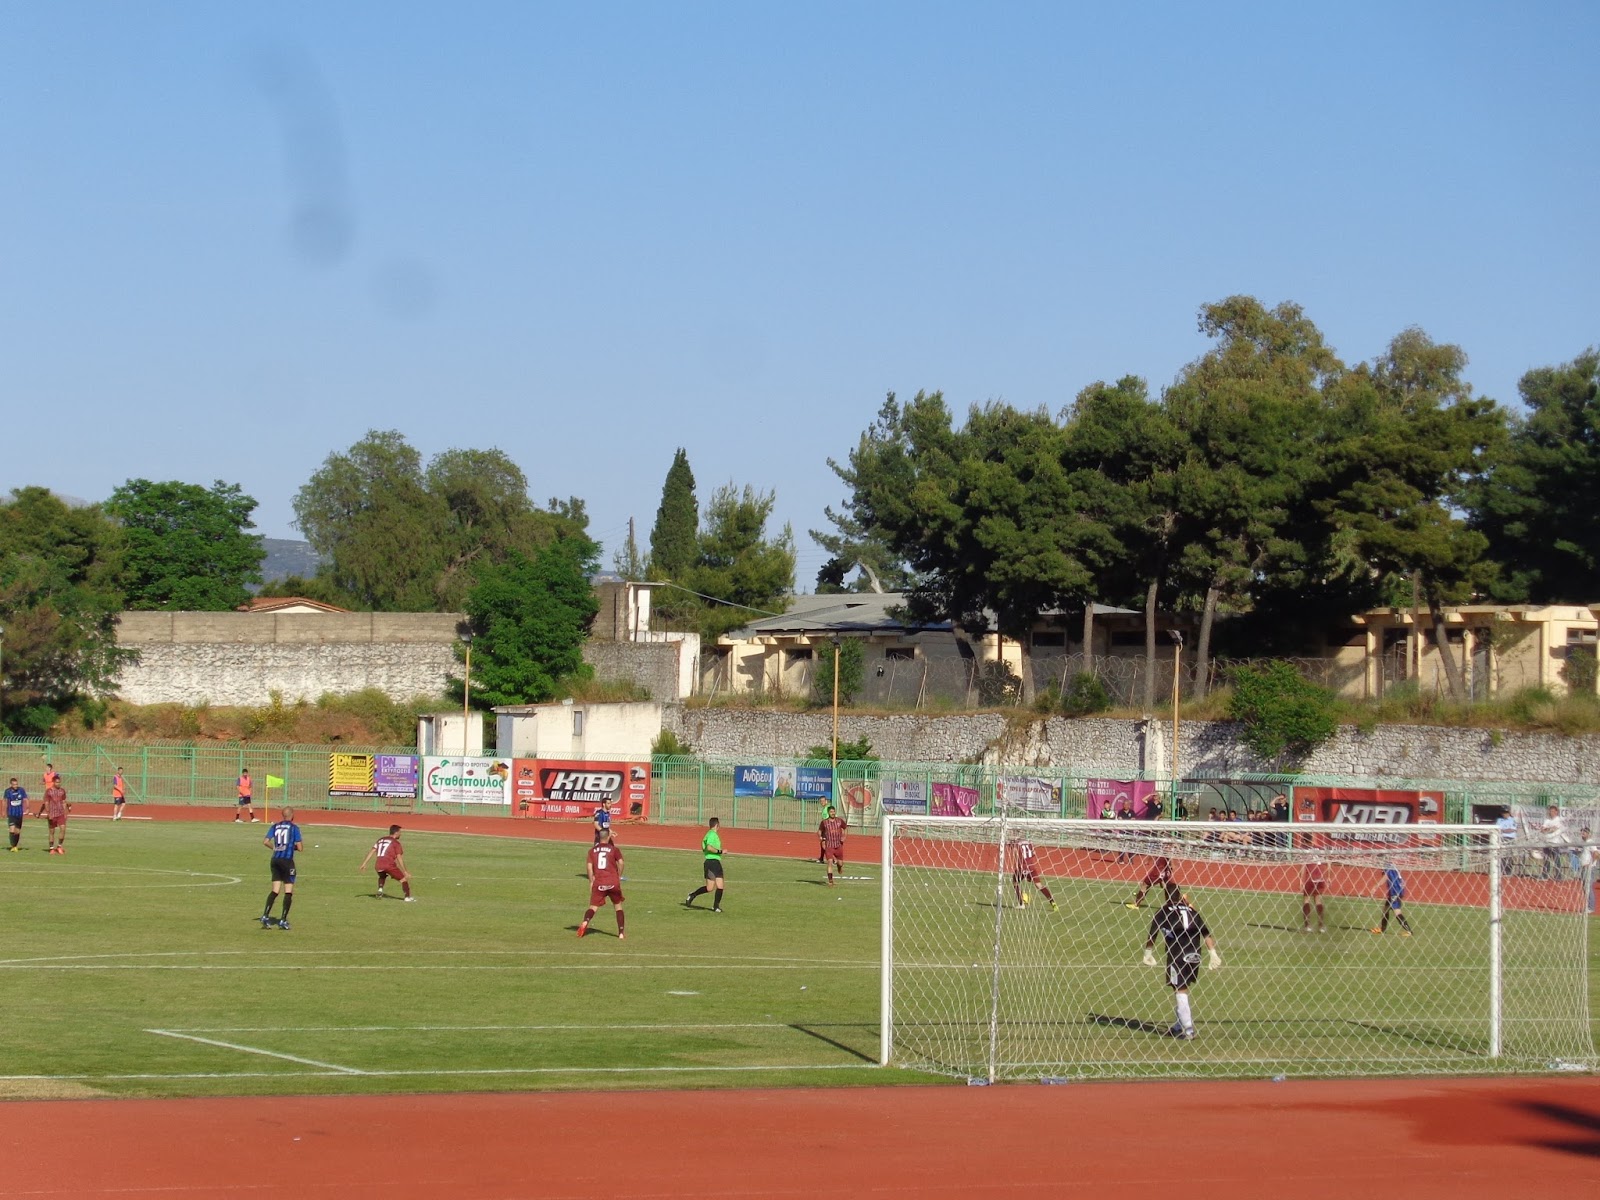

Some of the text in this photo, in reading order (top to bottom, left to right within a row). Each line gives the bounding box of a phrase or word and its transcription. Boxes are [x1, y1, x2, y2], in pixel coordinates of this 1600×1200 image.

[337, 755, 352, 766] DN
[382, 757, 396, 768] DN
[274, 829, 288, 844] 11
[377, 842, 390, 857] 17
[597, 852, 607, 869] 6
[1180, 910, 1189, 929] 1
